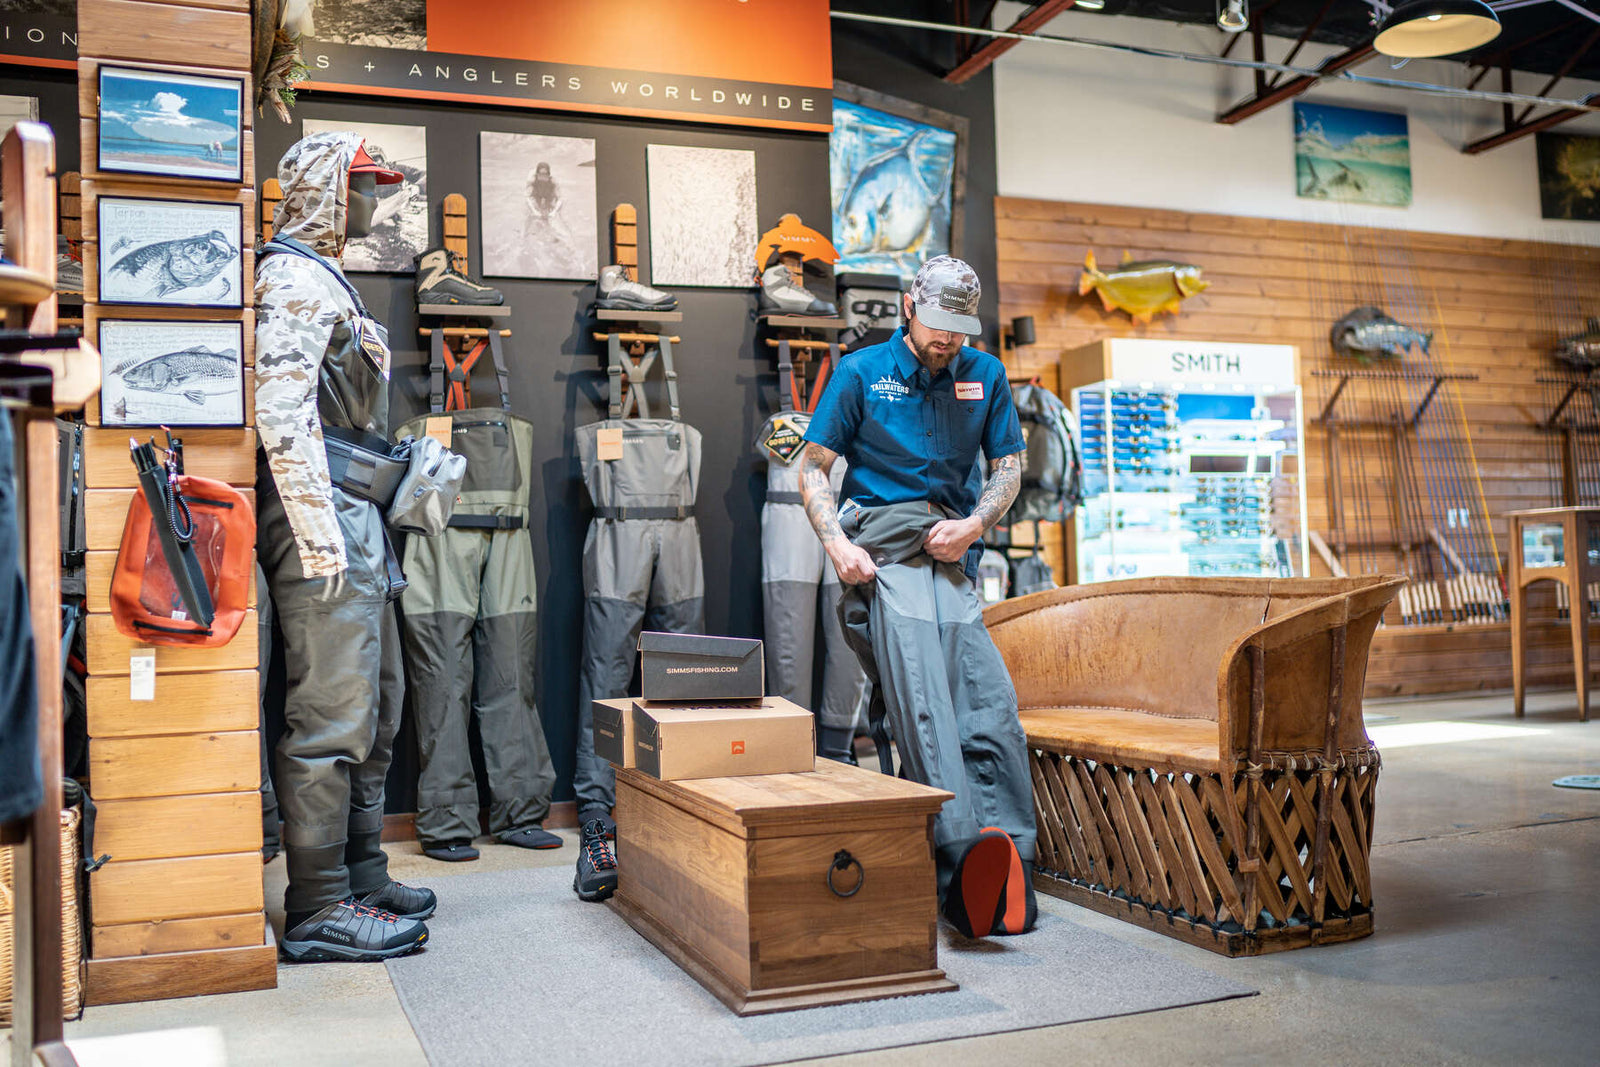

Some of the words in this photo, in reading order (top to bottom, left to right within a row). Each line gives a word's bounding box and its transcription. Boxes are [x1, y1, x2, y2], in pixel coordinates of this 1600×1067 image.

[408, 63, 581, 91] ANGLERS
[611, 81, 815, 111] WORLDWIDE
[1171, 351, 1240, 373] SMITH
[870, 383, 910, 394] TAILWATERS
[666, 666, 738, 674] SIMMSFISHING.COM
[321, 926, 350, 942] SIMMS
